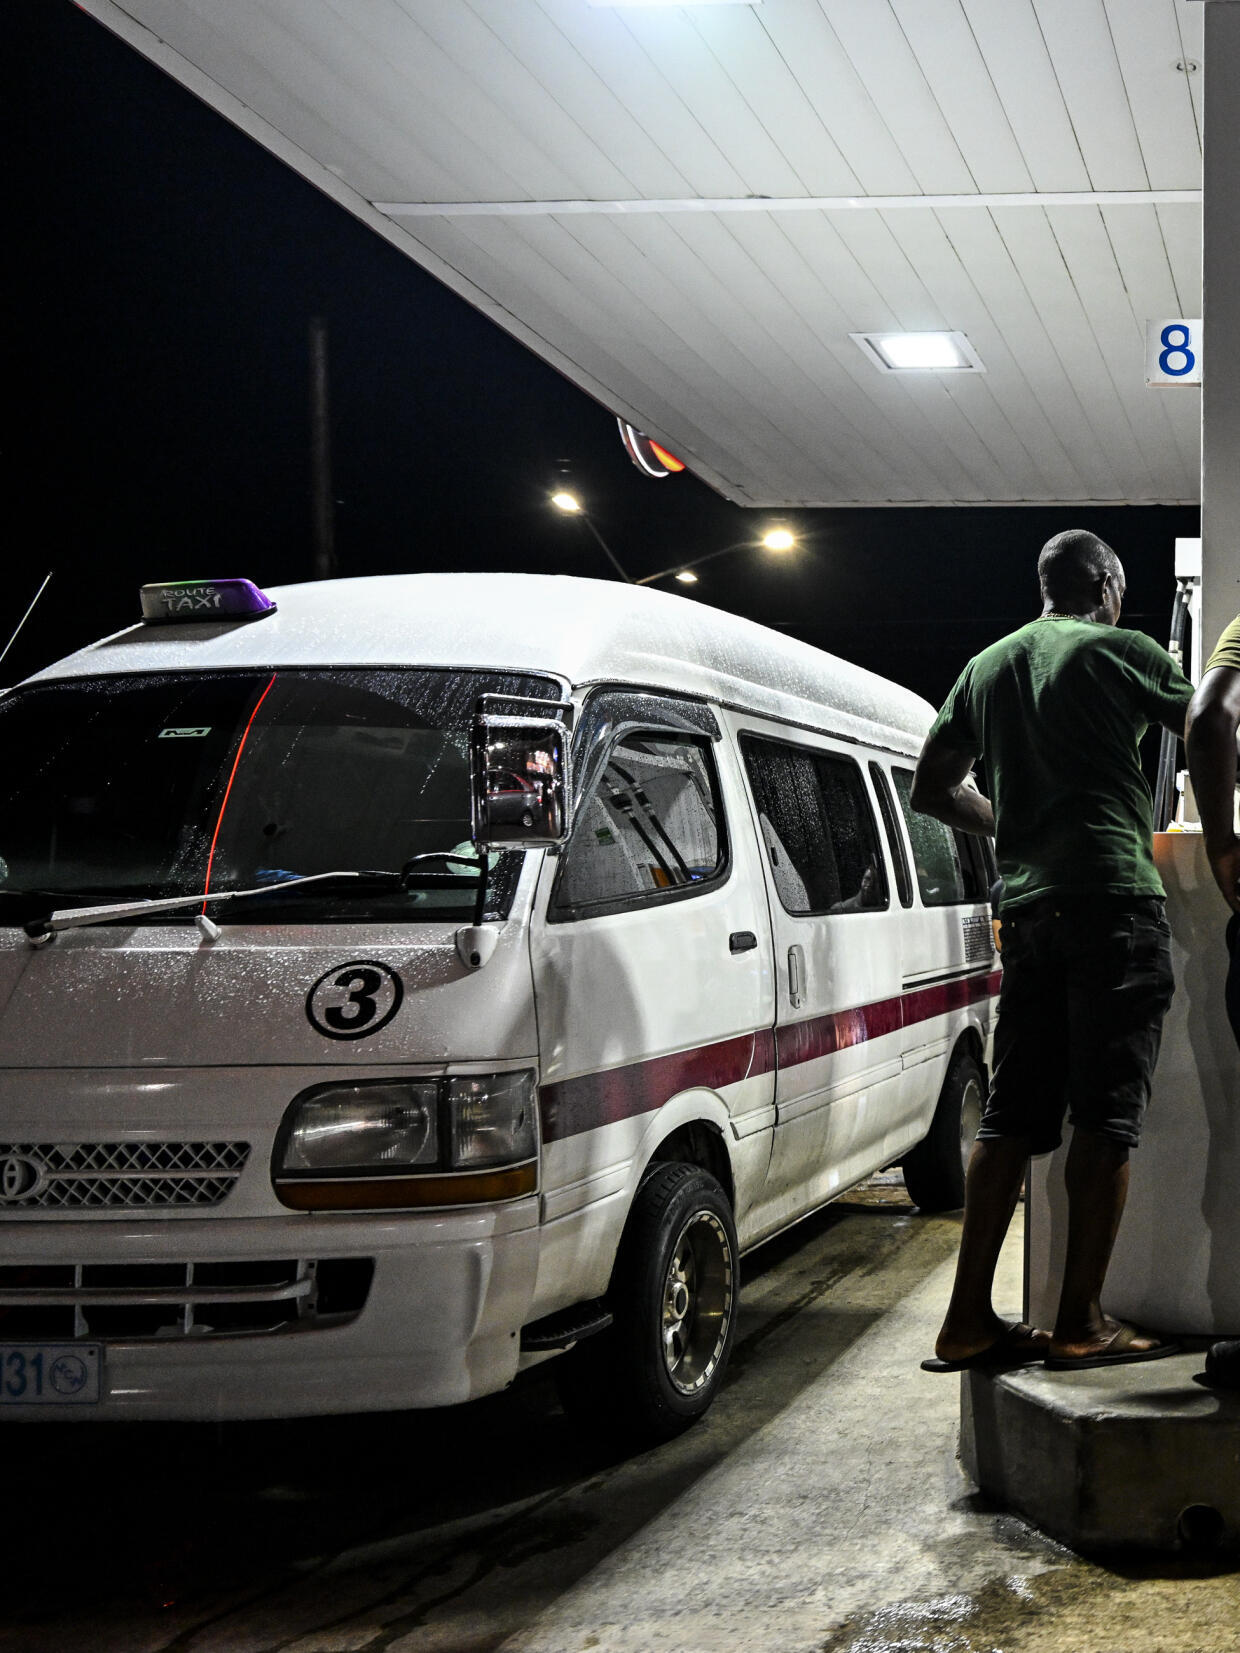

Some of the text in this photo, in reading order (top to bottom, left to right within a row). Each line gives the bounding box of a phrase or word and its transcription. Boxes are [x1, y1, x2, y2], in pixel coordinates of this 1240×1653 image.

[1158, 323, 1196, 377] 8
[162, 586, 216, 598] ROUTE
[163, 593, 223, 612] TAXI
[324, 967, 382, 1031] 3
[0, 1351, 44, 1397] 31
